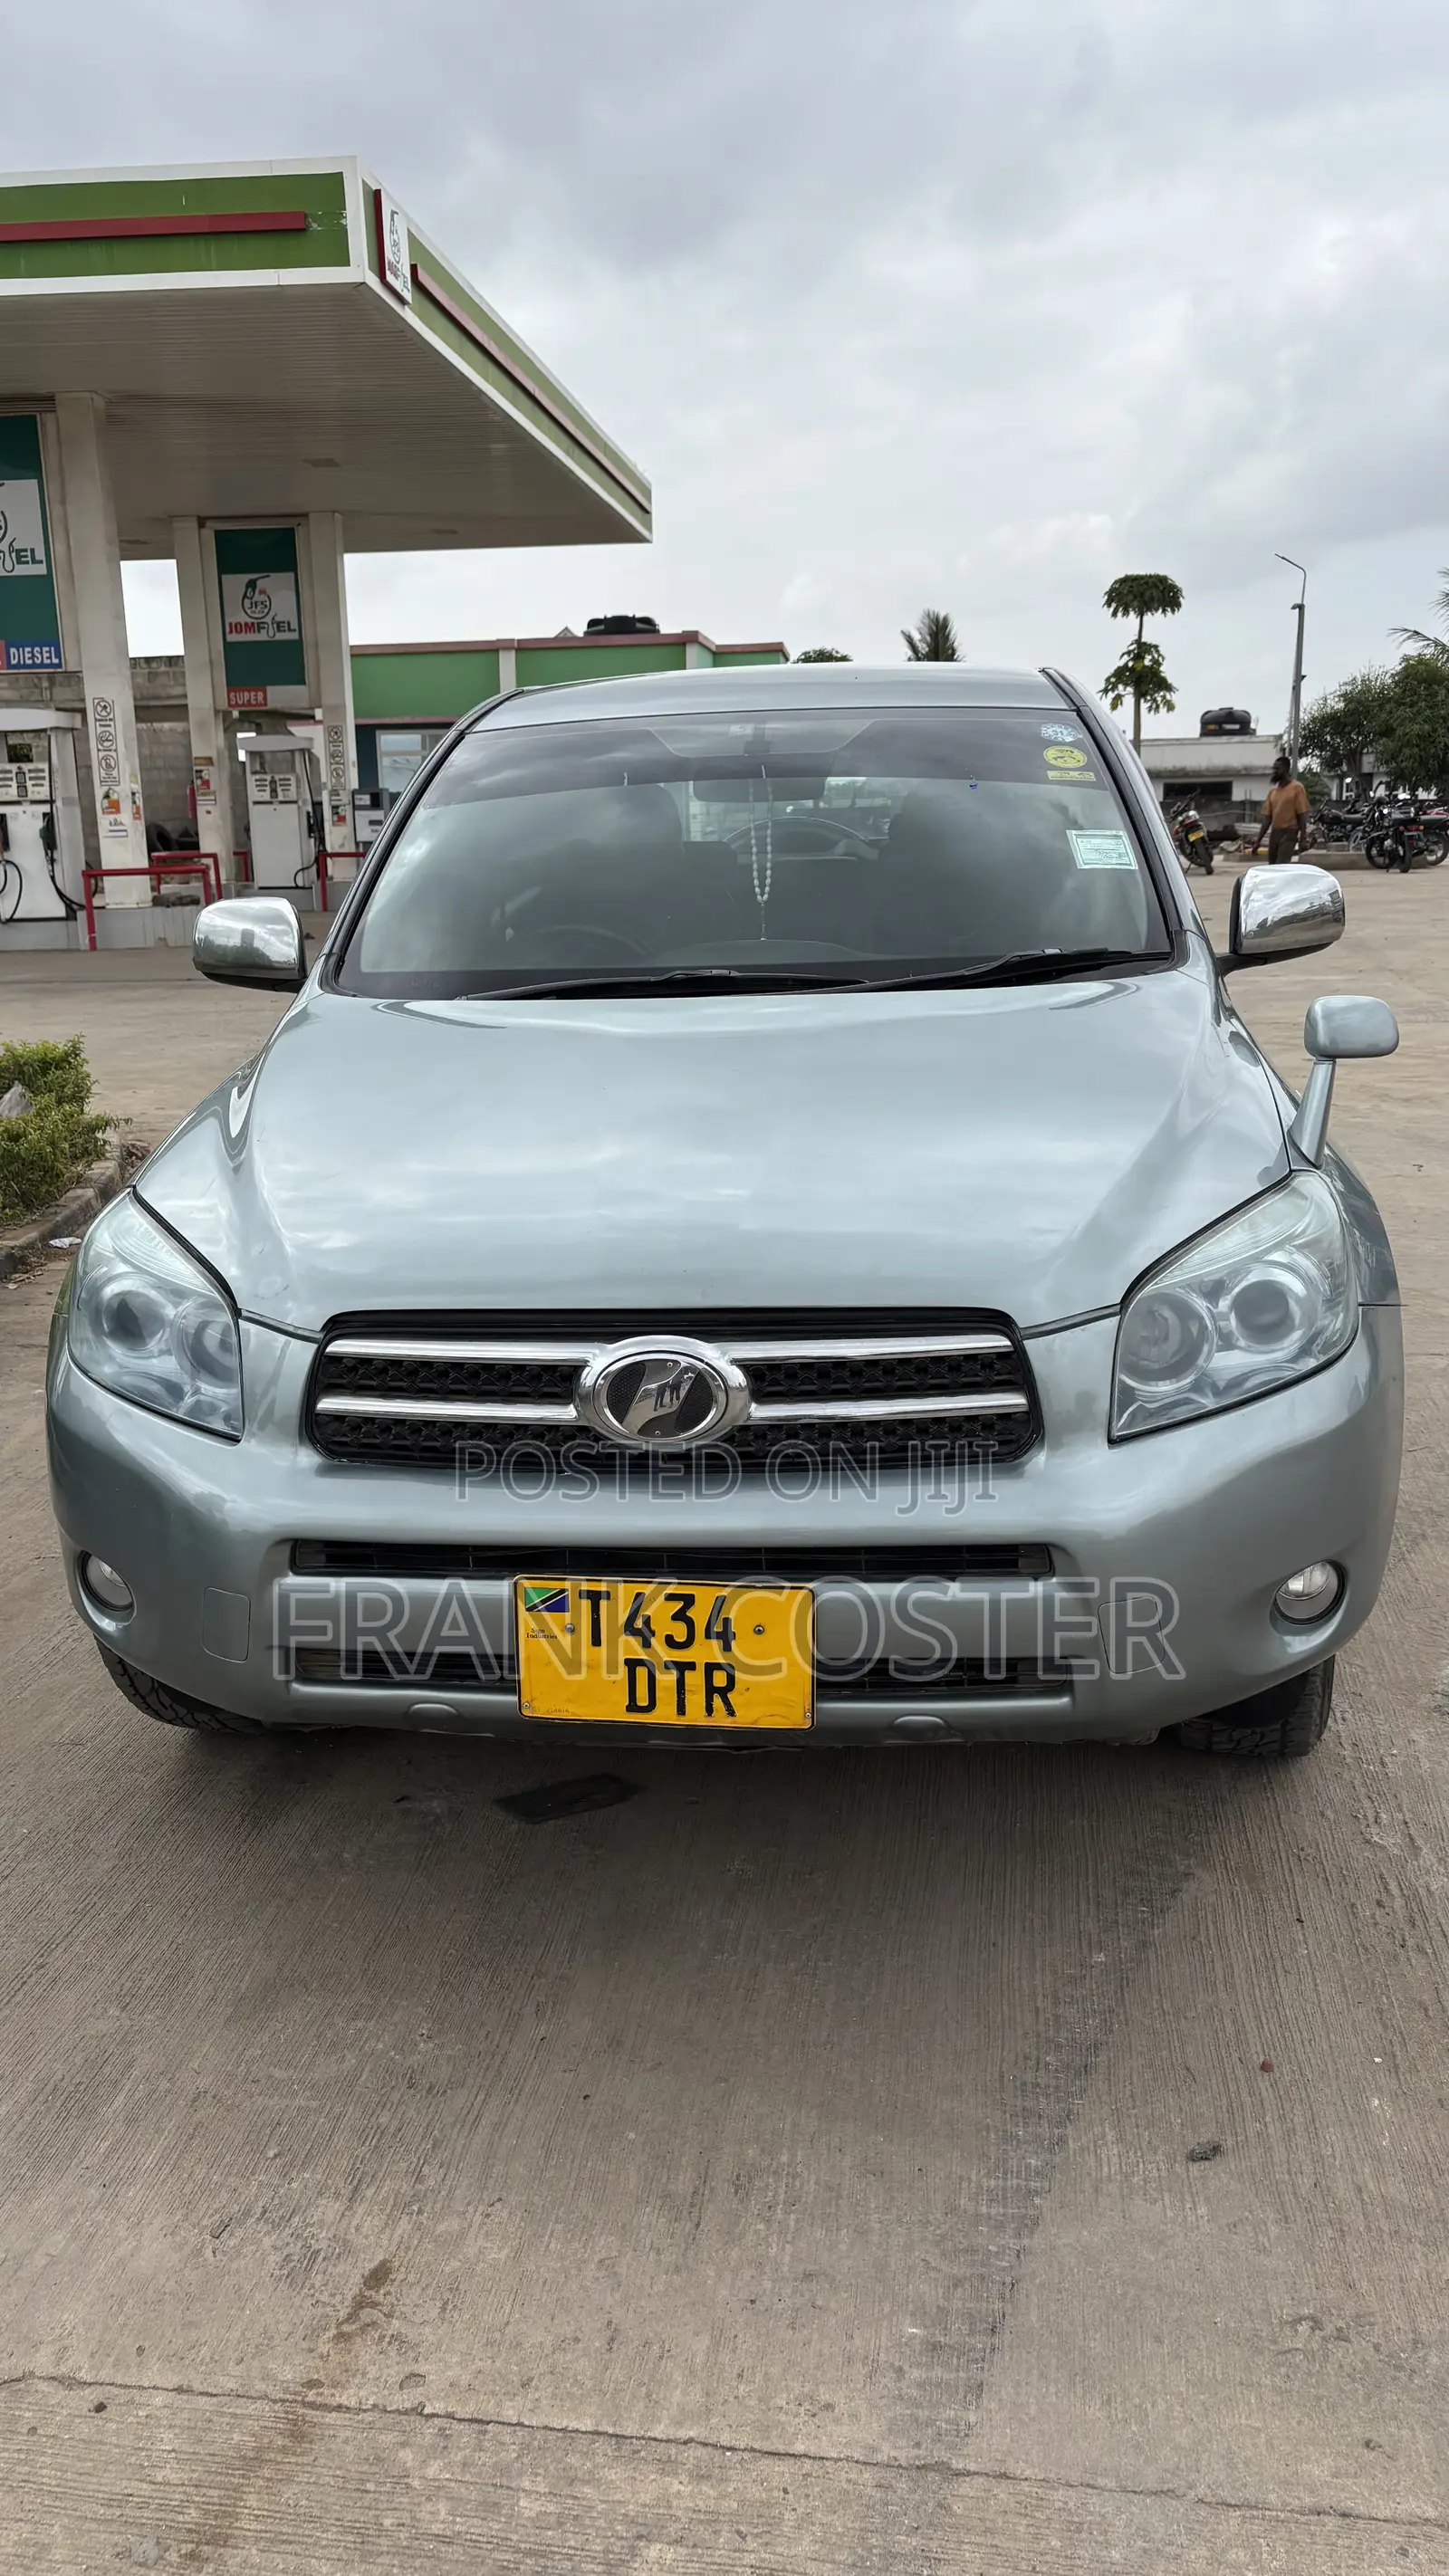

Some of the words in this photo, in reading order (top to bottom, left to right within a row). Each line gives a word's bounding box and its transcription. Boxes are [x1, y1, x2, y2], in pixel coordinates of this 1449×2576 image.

[10, 646, 59, 665] DIESEL
[229, 691, 264, 704] SUPER
[624, 1658, 737, 1718] DTR
